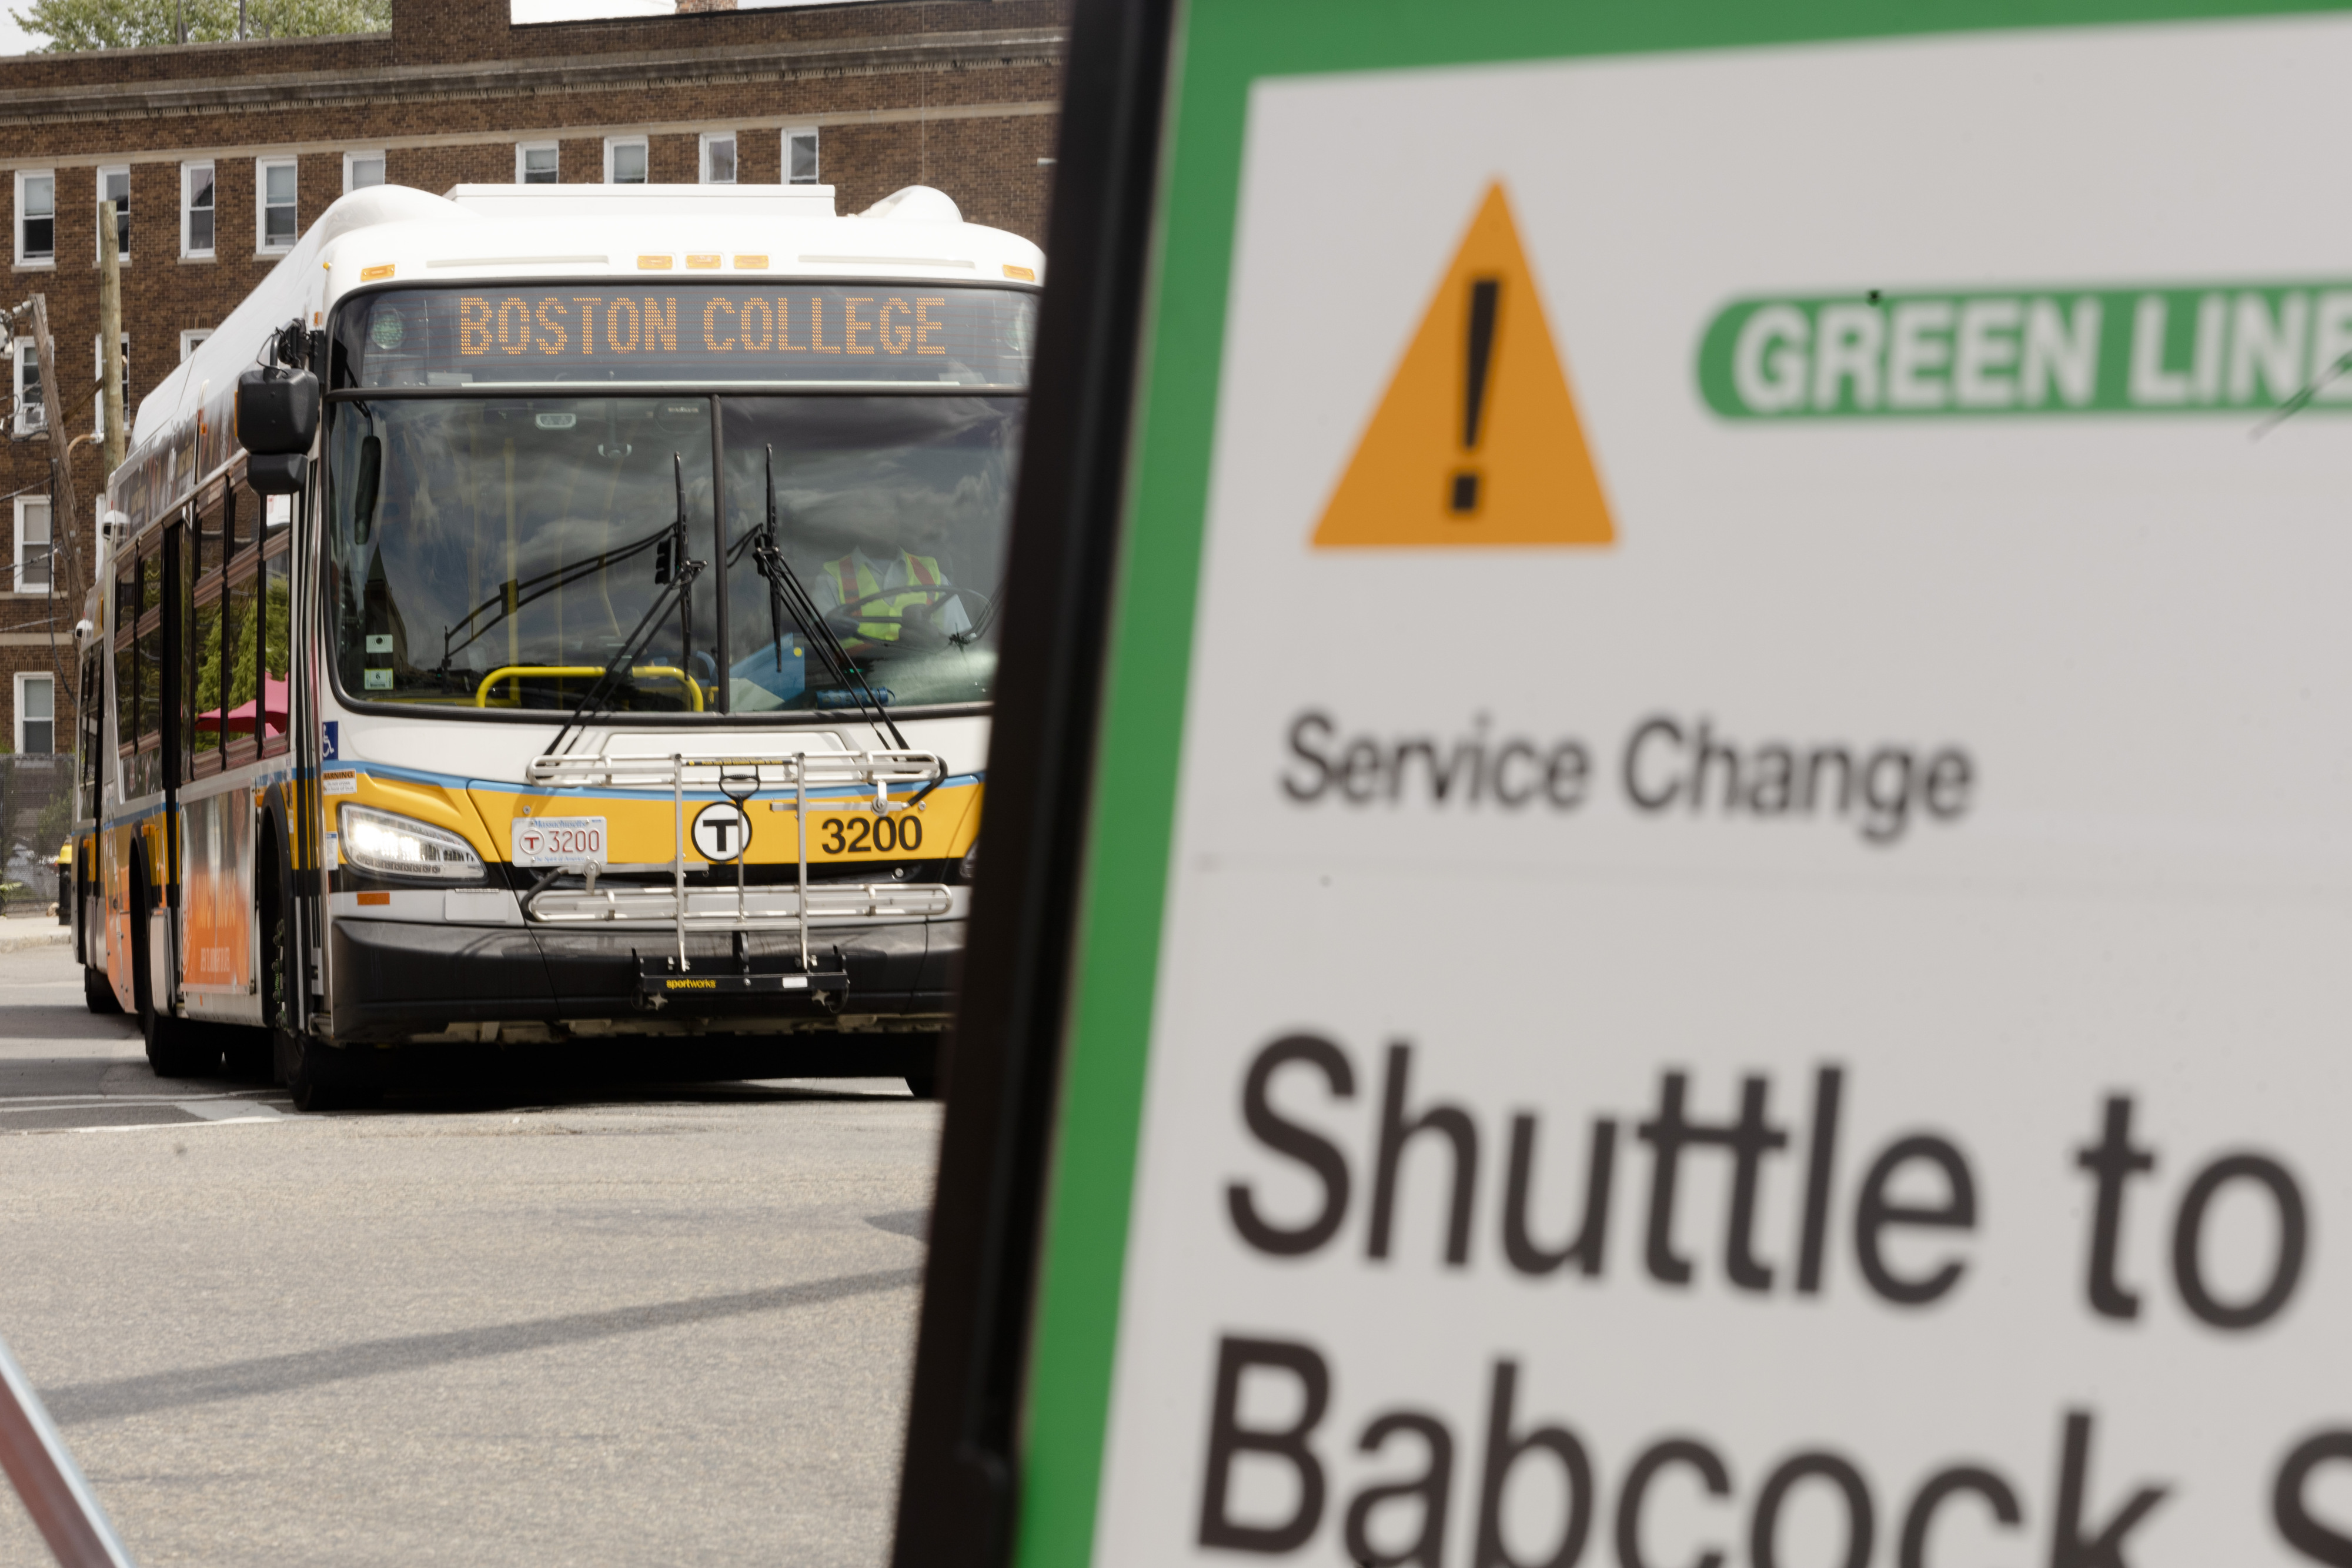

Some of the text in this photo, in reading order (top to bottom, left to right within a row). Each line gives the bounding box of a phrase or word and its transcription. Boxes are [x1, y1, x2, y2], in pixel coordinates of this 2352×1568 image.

[461, 297, 946, 355] BOSTON COLLEGE
[1732, 291, 2352, 410] GREEN LINE
[1278, 707, 1977, 847] Service Change
[534, 820, 586, 828] Massachusetts
[548, 829, 600, 852] 3200
[821, 815, 923, 854] 3200
[666, 978, 717, 990] sportworks
[1222, 1029, 2313, 1336] Shuttle to
[1192, 1330, 2172, 1568] Babcock
